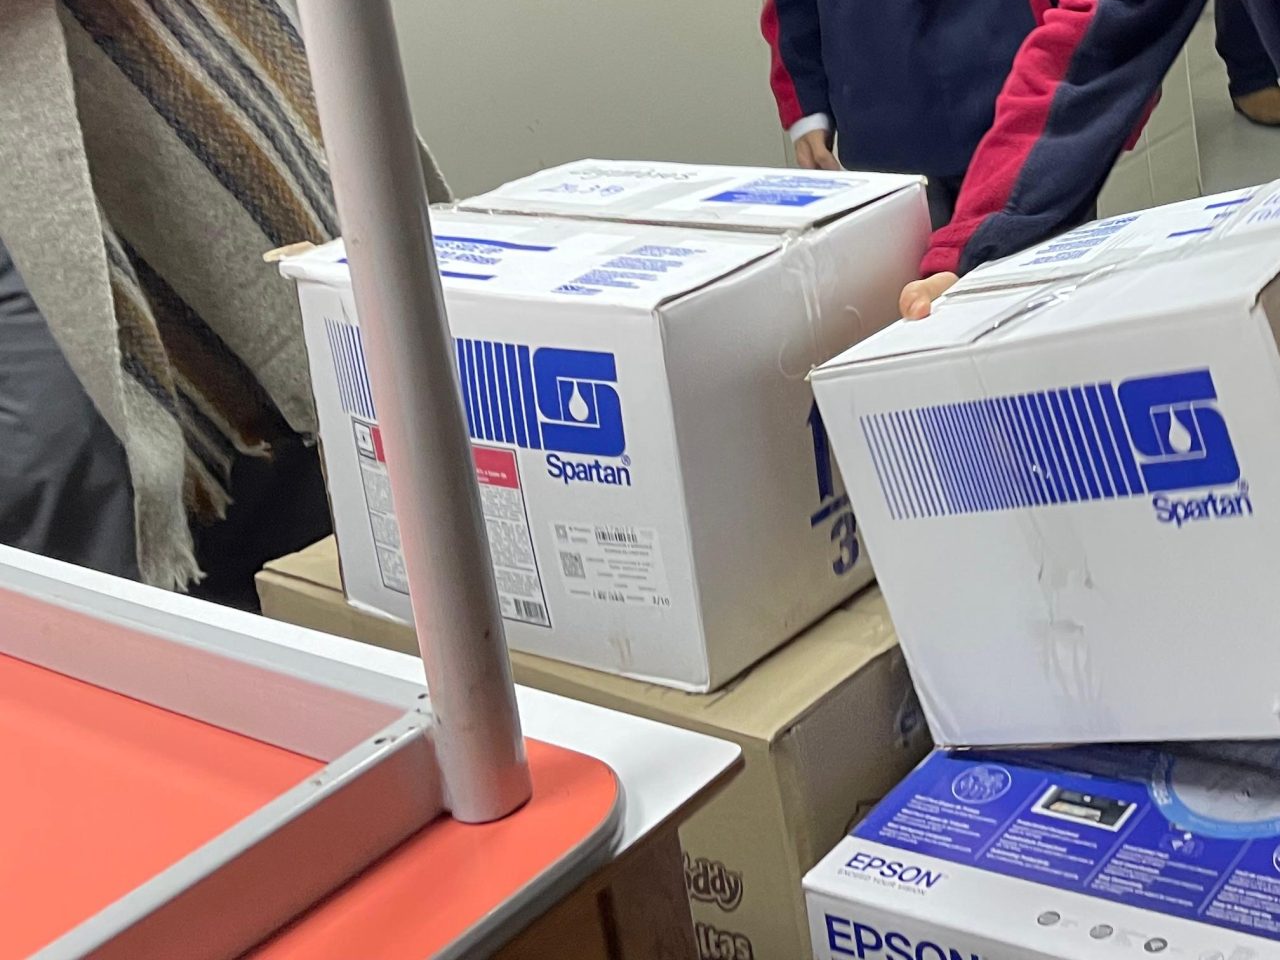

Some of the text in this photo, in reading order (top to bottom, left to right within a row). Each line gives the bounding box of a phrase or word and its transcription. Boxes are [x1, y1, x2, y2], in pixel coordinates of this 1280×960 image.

[545, 453, 632, 487] Spartan
[1152, 491, 1254, 529] Spartan
[844, 851, 942, 889] EPSON
[824, 912, 978, 960] EPSO
